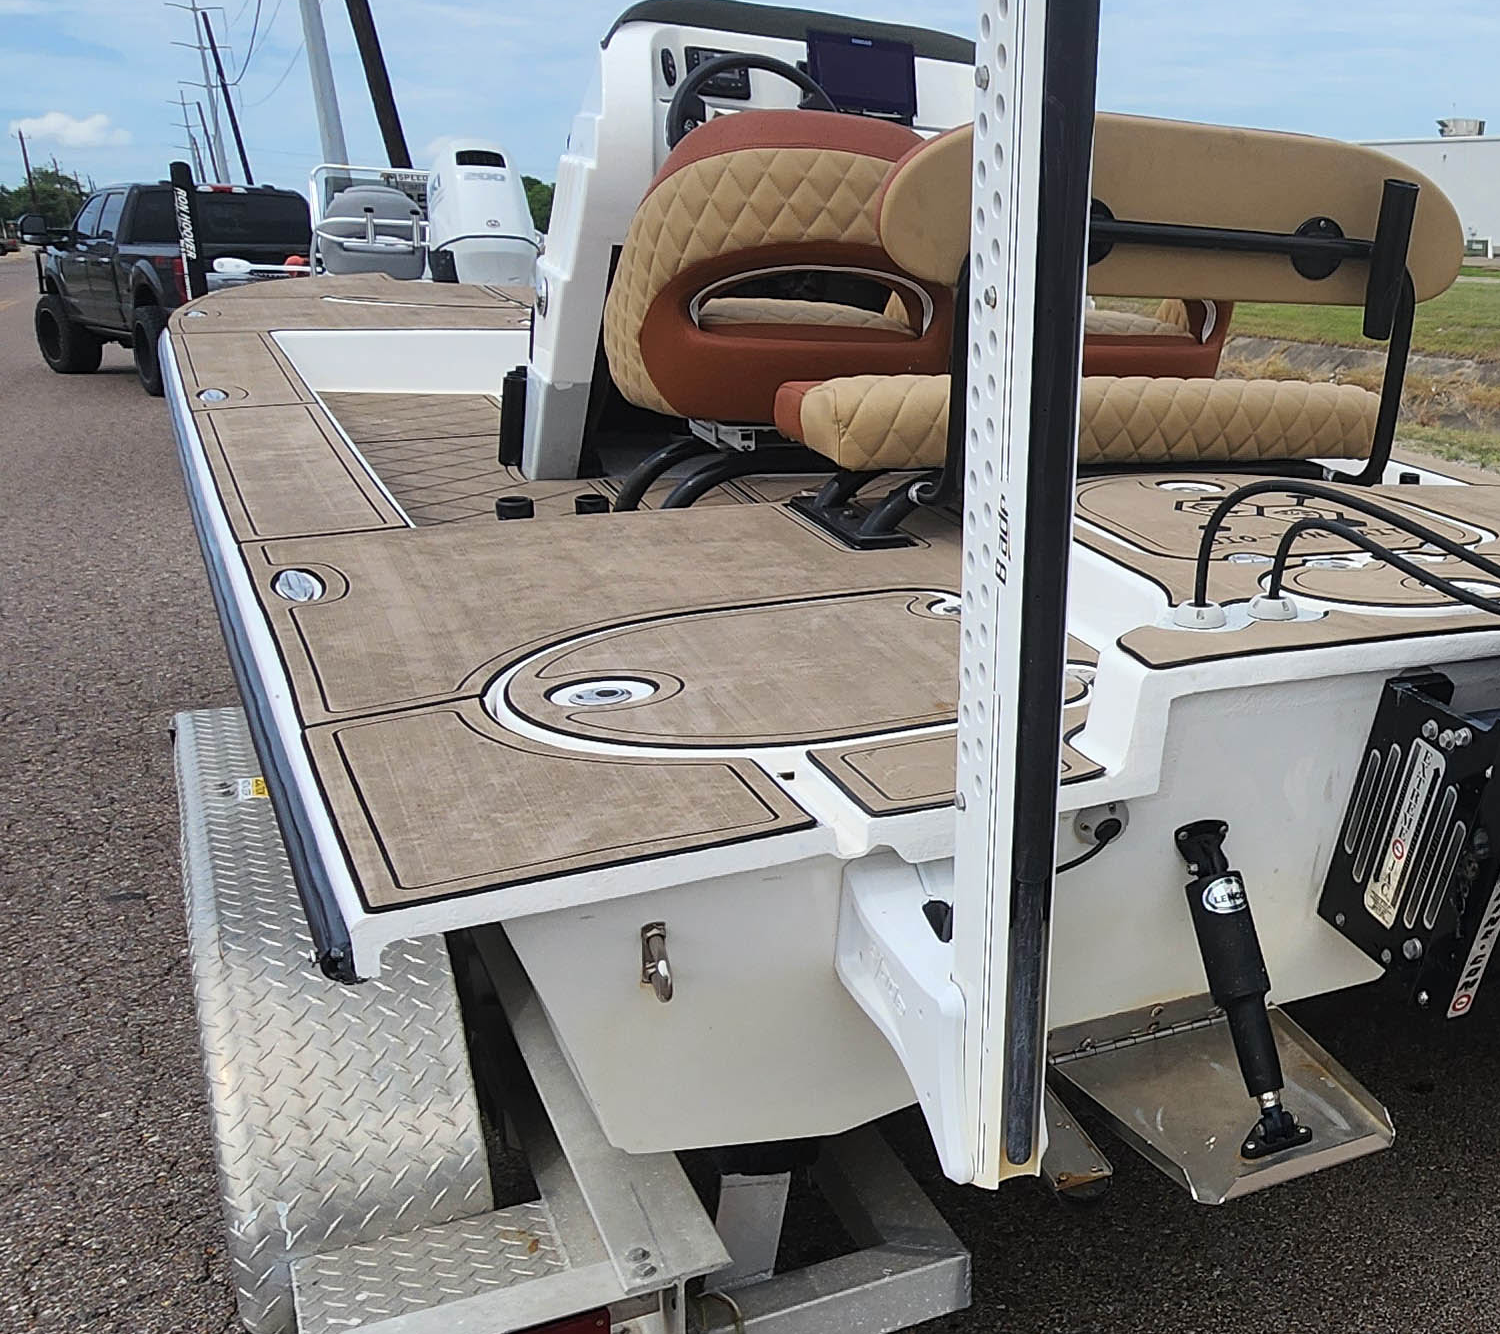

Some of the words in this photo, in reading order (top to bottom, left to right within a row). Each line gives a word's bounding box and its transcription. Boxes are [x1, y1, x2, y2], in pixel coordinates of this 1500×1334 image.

[398, 173, 429, 182] SPEED
[173, 186, 190, 214] RON
[178, 212, 198, 260] HOOVER
